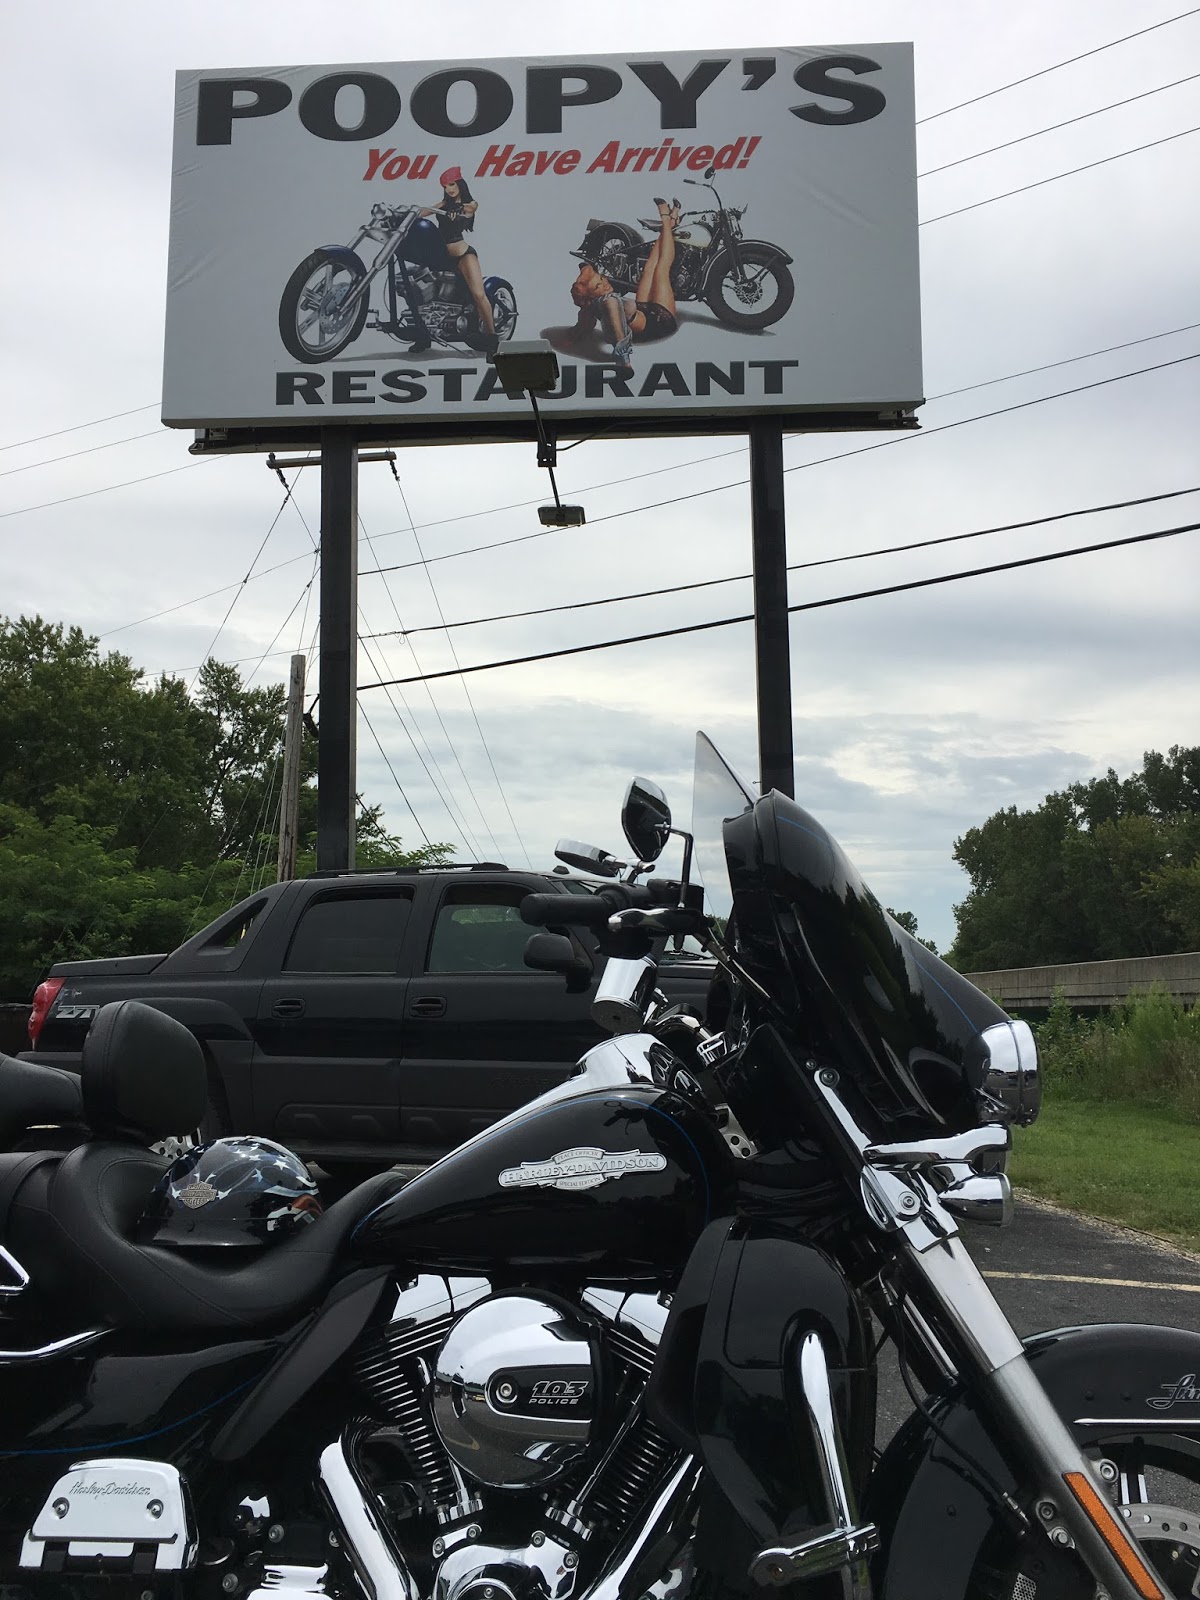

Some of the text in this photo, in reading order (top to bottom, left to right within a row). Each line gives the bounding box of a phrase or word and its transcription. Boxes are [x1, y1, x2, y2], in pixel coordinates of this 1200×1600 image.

[362, 135, 763, 181] You Have Arrived!
[275, 360, 799, 406] RESTAURANT
[502, 1156, 661, 1184] HARLEY-DAVIDSON
[531, 1380, 589, 1398] 103
